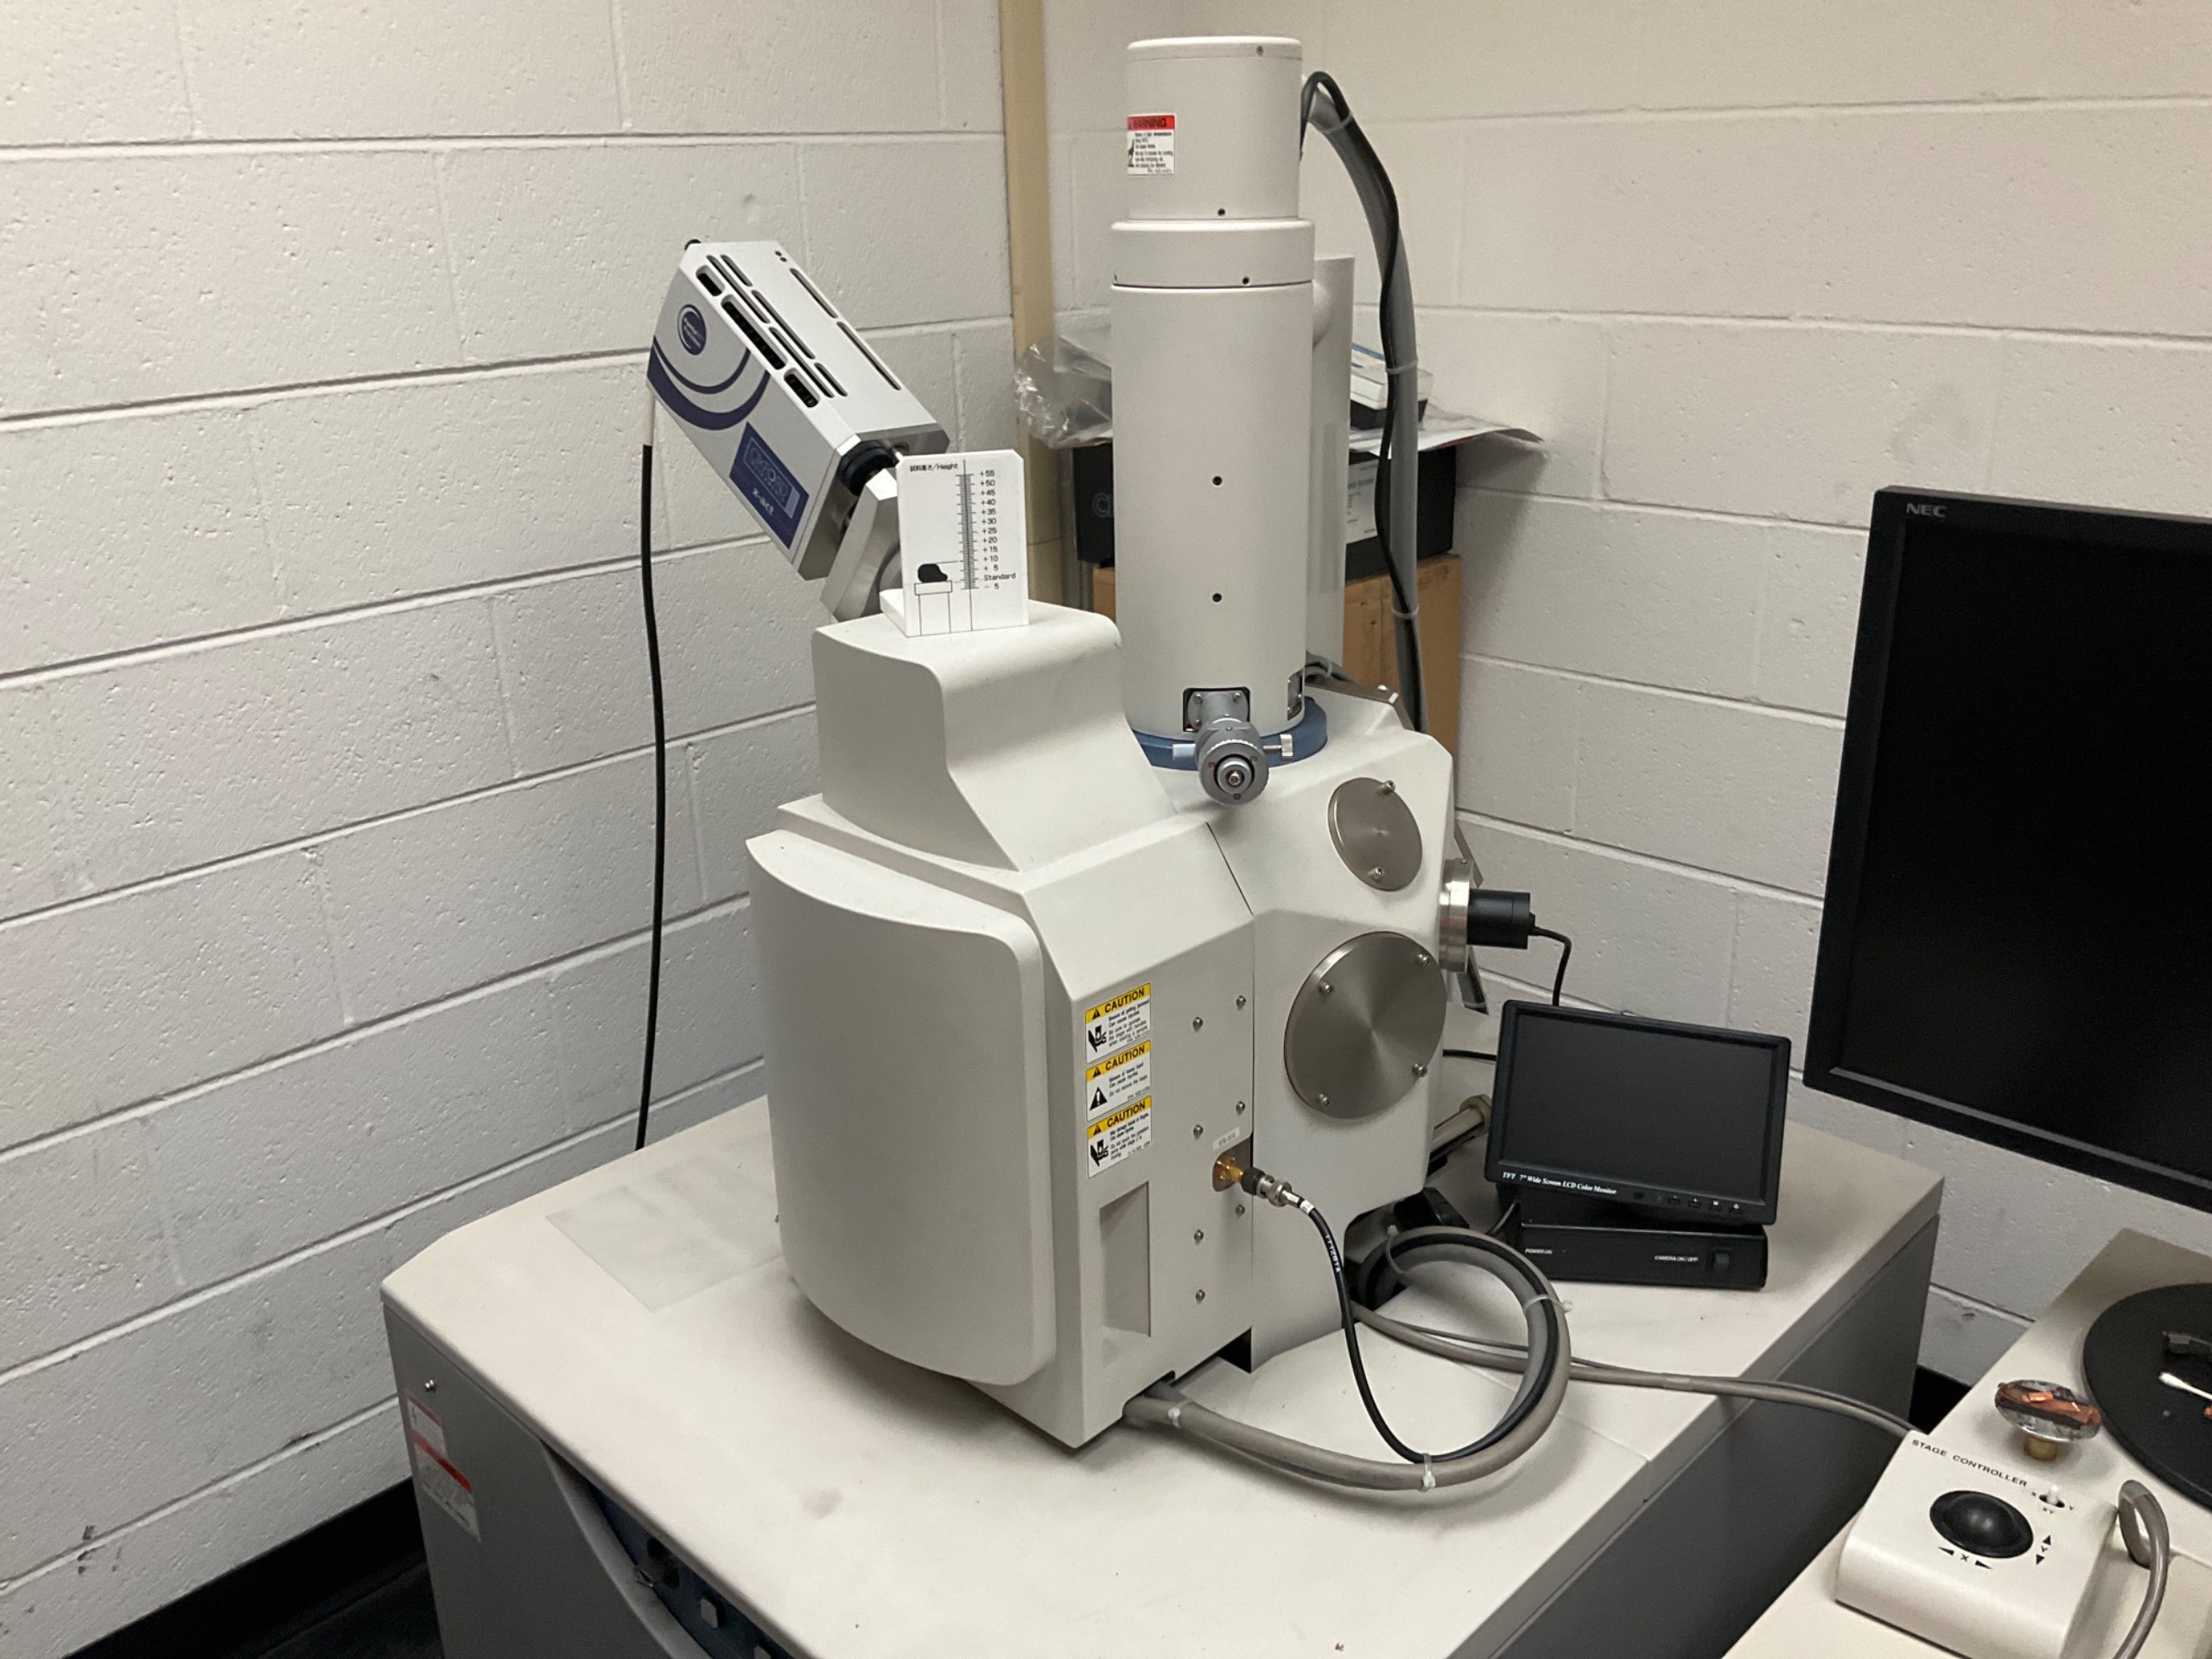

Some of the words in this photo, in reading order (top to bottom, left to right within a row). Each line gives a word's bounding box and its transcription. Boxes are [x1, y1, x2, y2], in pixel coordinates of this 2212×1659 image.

[1906, 503, 1948, 518] NEC
[1104, 988, 1145, 1014] CAUTION
[1106, 1045, 1146, 1071] CAUTION
[1107, 1101, 1146, 1128] CAUTION
[1527, 1175, 1541, 1184] Wide
[1541, 1179, 1562, 1187] Screen
[1562, 1180, 1576, 1189] LCD
[1577, 1182, 1593, 1192] Color
[1593, 1185, 1618, 1195] Monitor
[1911, 1440, 1948, 1457] STAGE
[1953, 1454, 2027, 1487] CONTROLLER
[1960, 1554, 1970, 1562] X
